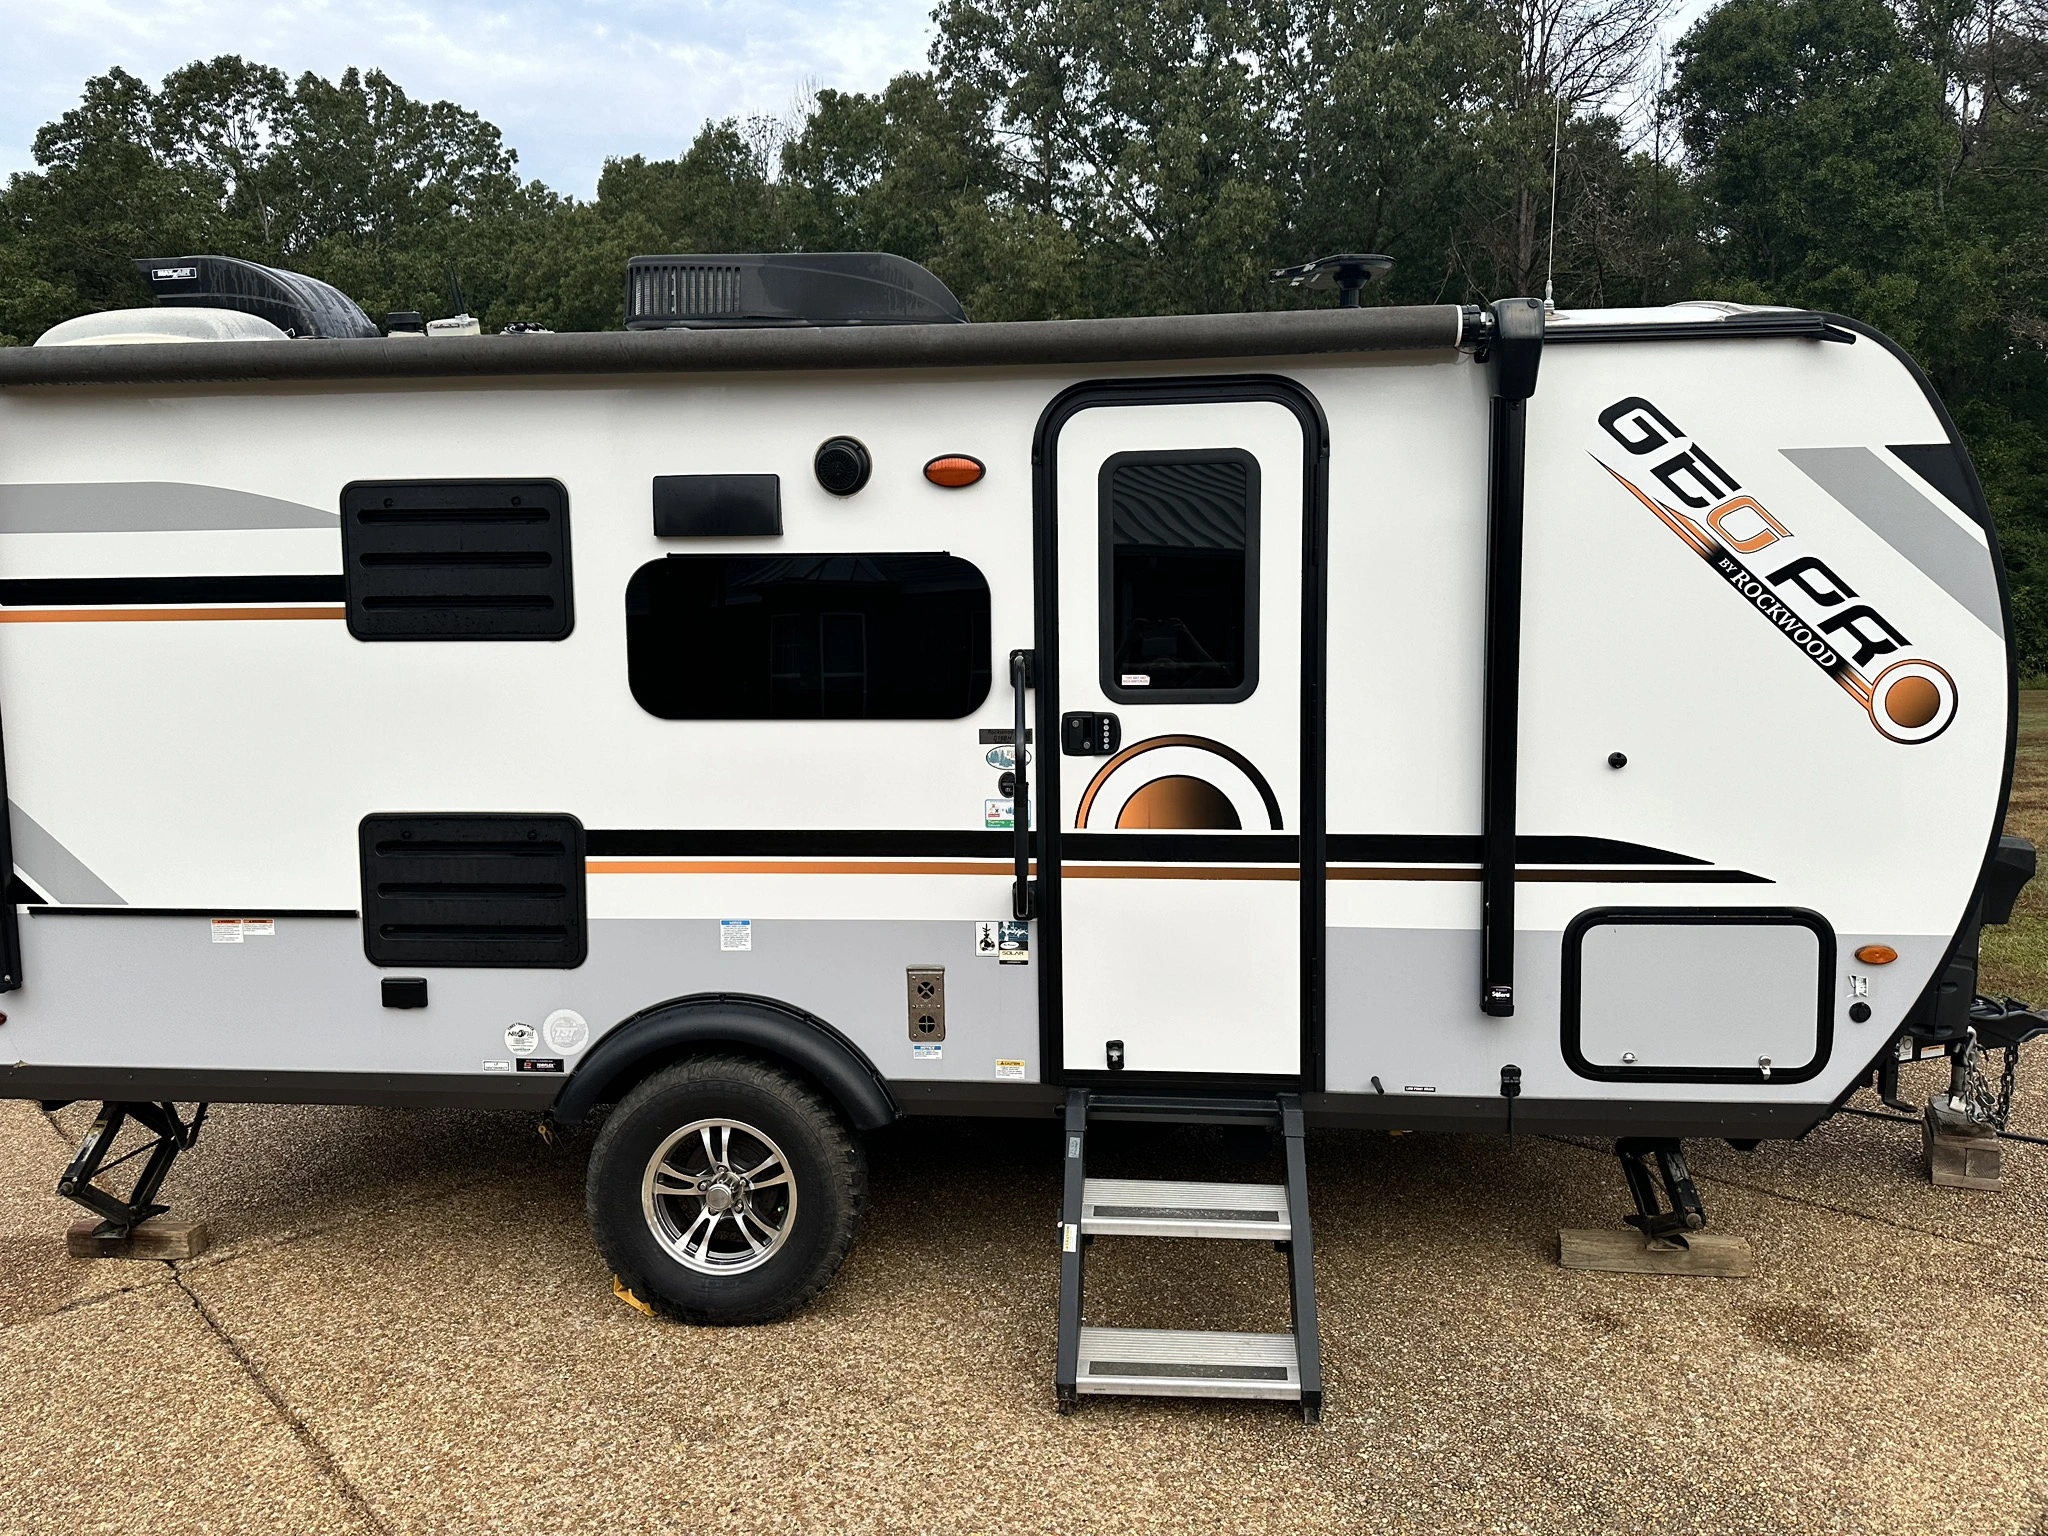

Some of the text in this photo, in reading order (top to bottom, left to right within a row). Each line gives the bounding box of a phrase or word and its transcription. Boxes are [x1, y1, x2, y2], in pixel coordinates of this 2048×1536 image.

[1597, 396, 1794, 554] GEO
[1718, 557, 1838, 669] BY ROCKWOOD
